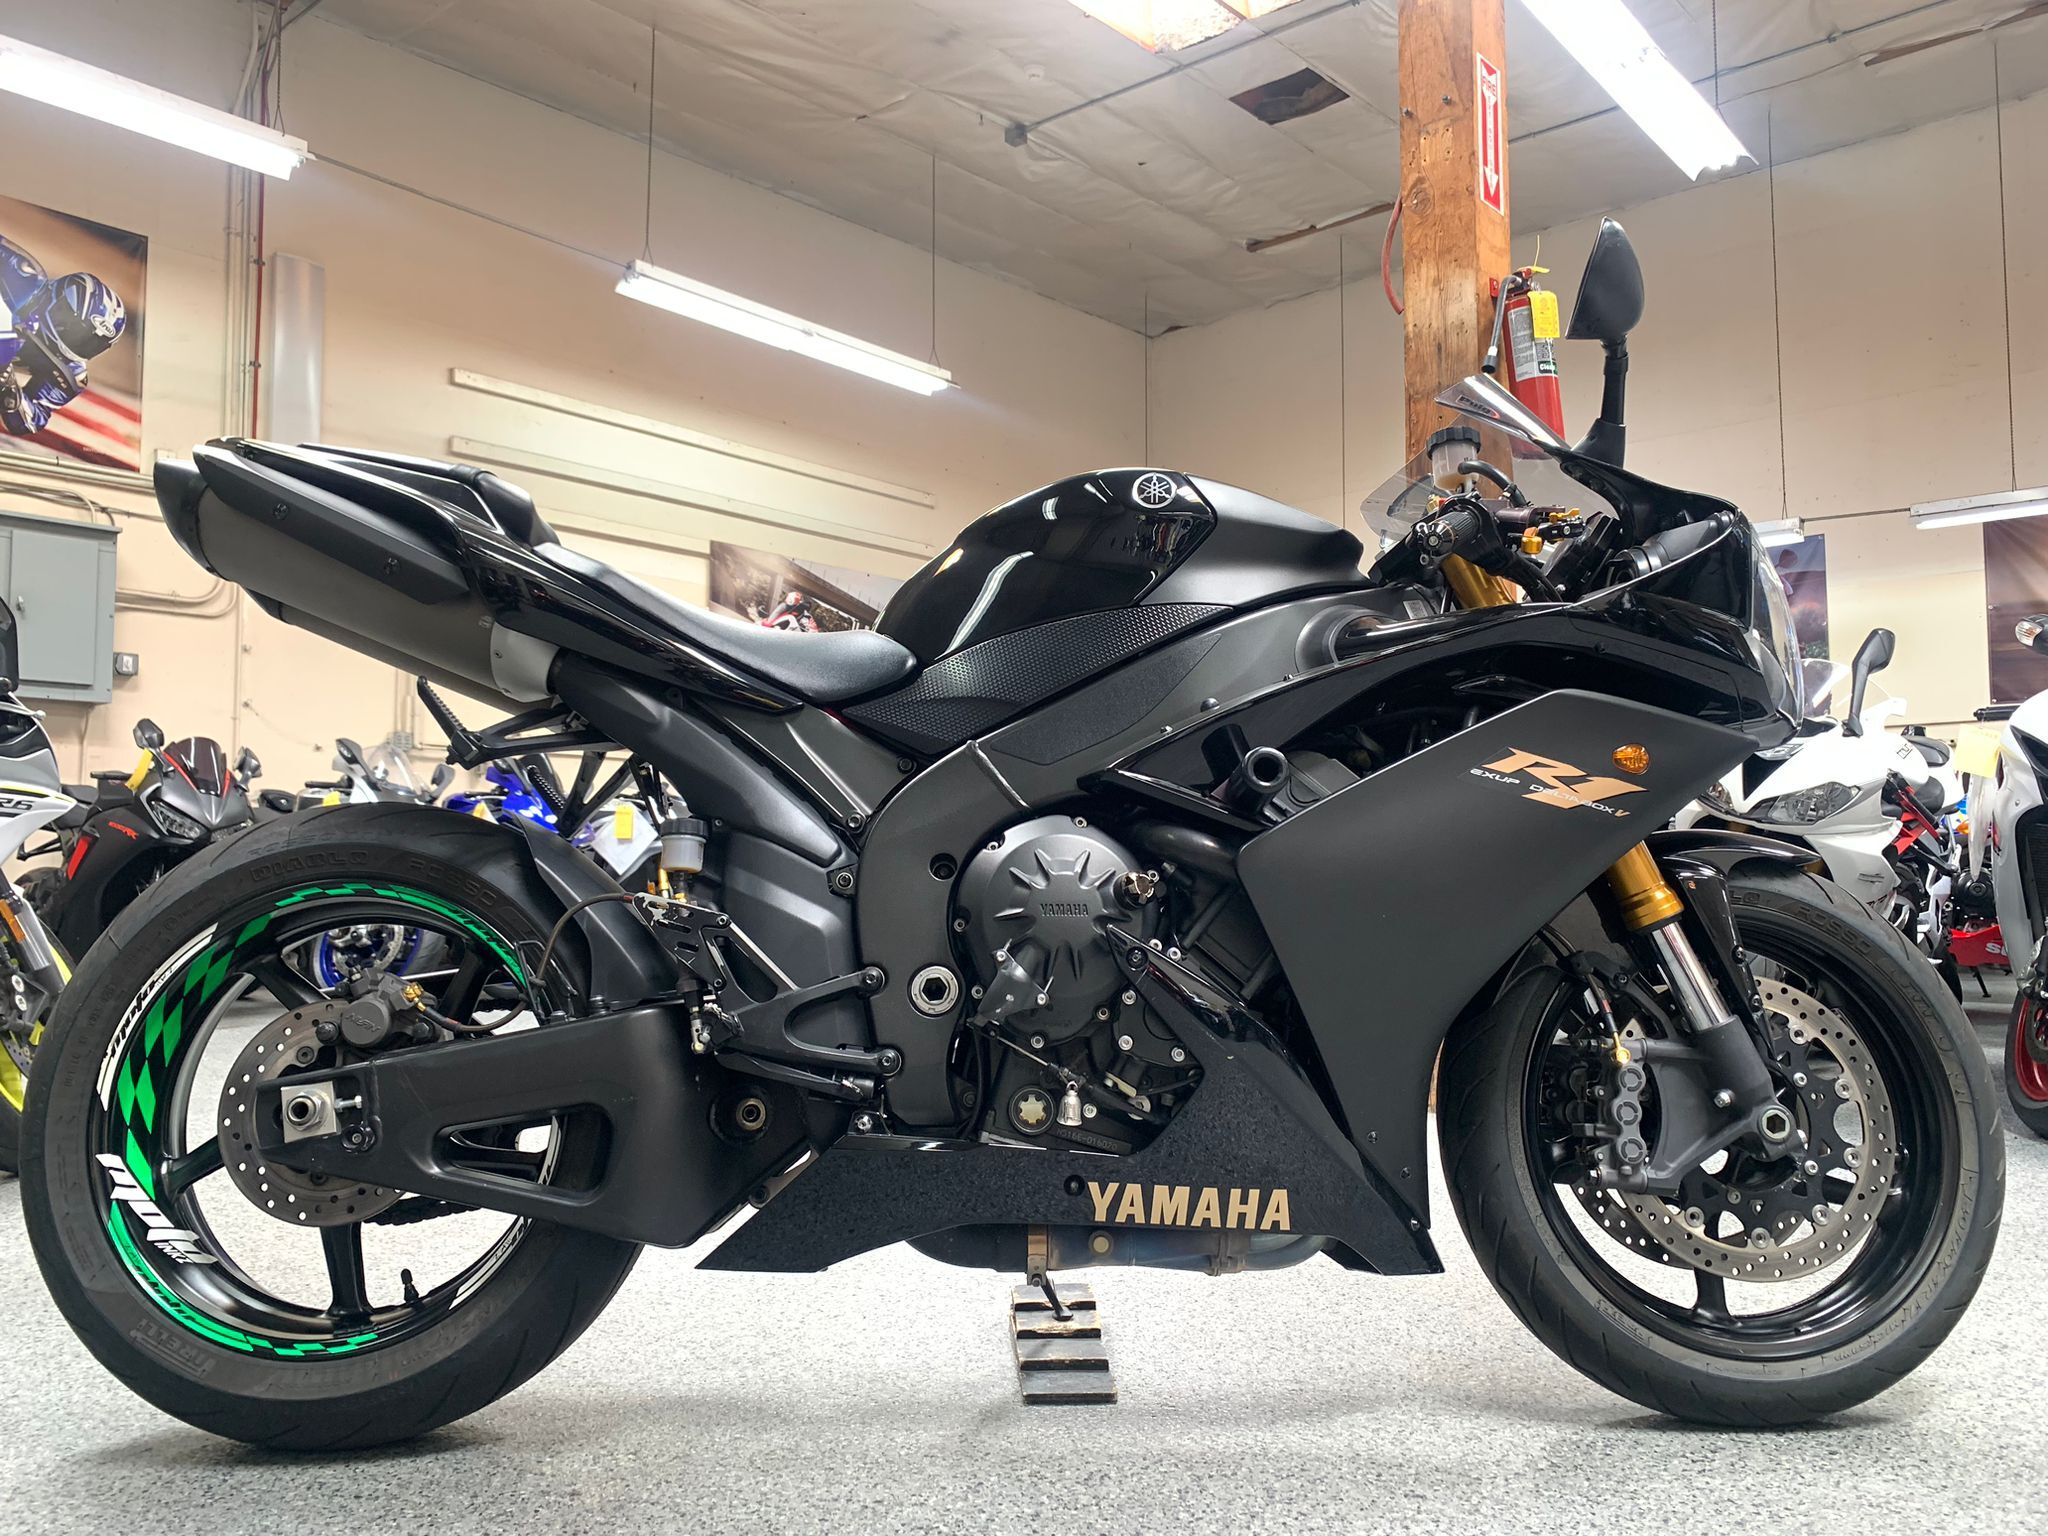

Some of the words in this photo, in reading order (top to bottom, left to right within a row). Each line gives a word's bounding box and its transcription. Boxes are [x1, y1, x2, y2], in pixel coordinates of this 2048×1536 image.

[1458, 395, 1492, 415] Puig
[1470, 768, 1521, 785] EXUP
[1529, 784, 1614, 815] DELTABOX
[1040, 903, 1089, 917] YAMAHA
[1796, 907, 1871, 951] ROSSO
[1087, 1181, 1292, 1231] YAMAHA
